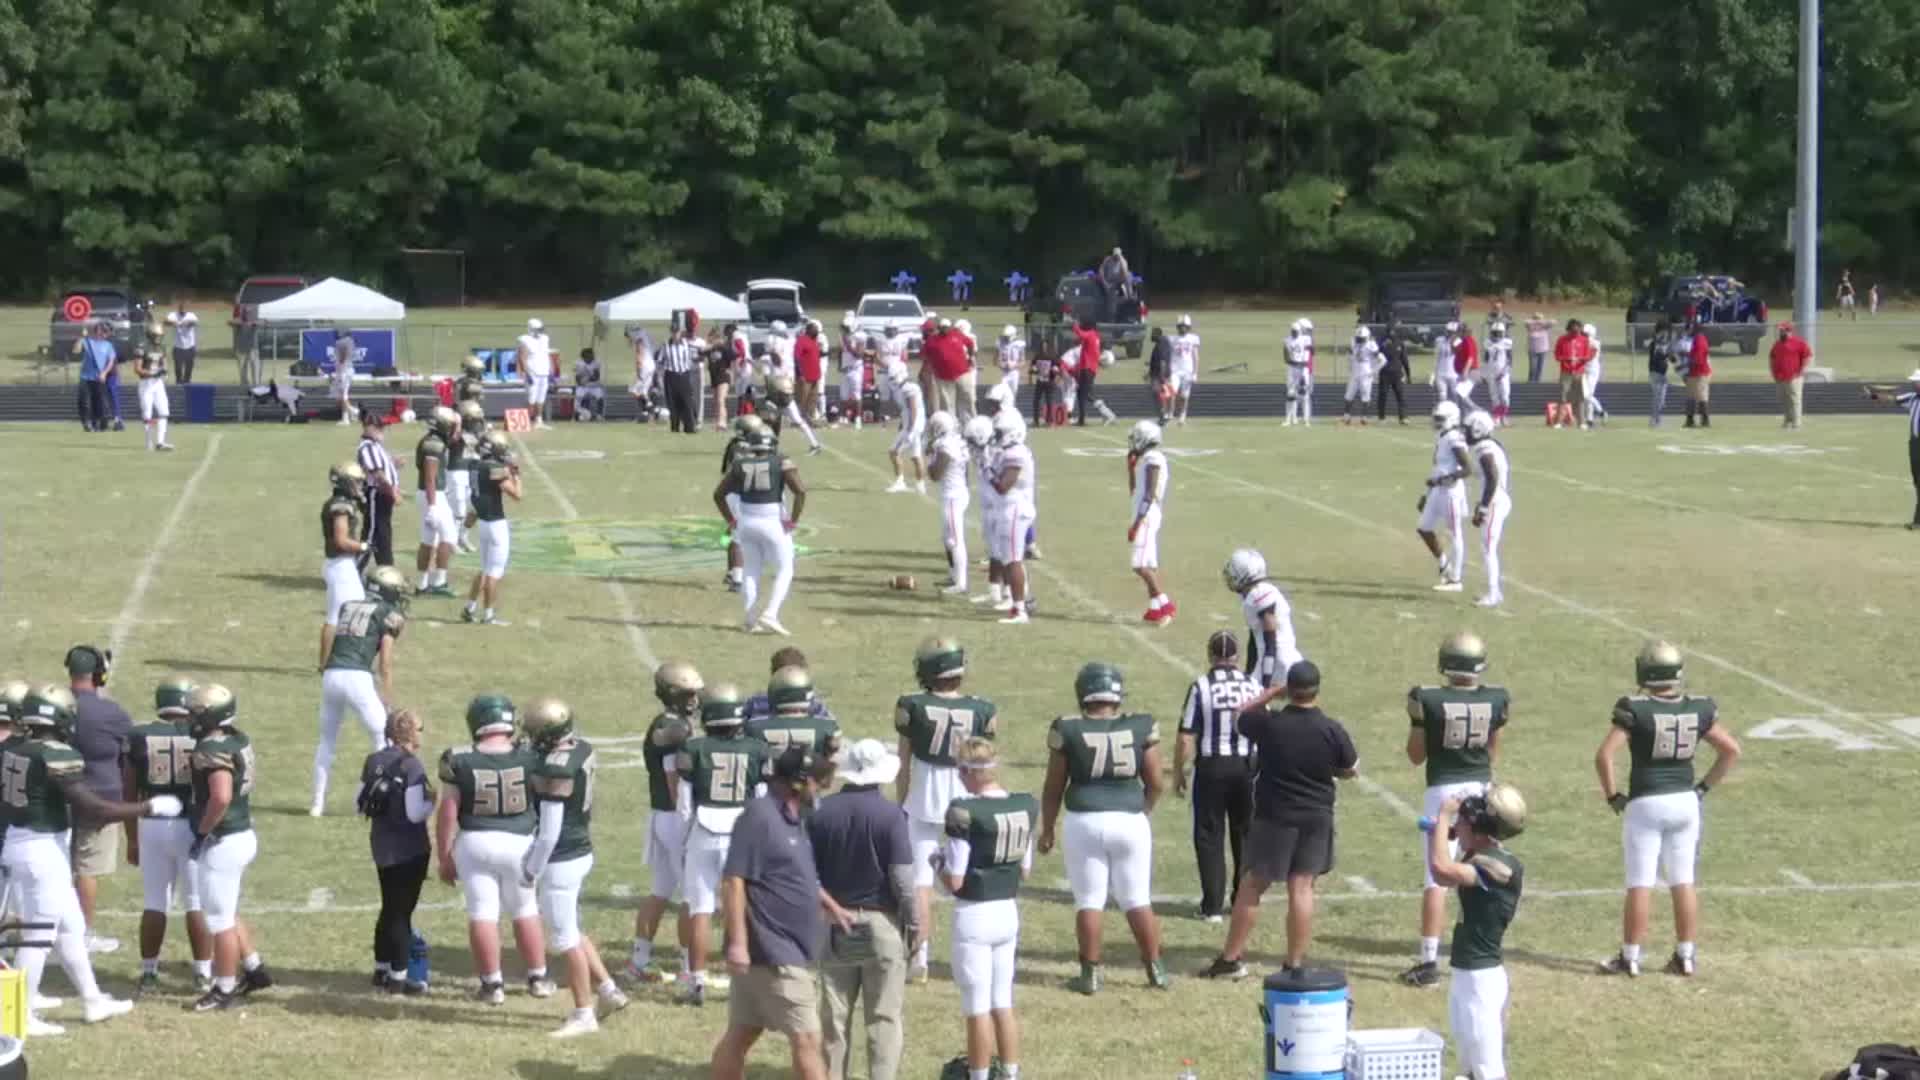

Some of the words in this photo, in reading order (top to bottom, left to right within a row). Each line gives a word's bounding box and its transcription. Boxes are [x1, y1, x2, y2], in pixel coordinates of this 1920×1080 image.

[508, 409, 529, 431] 50
[1209, 682, 1262, 710] 256
[1440, 702, 1492, 750] 69
[1652, 713, 1699, 761] 65
[145, 736, 197, 785] 66
[710, 752, 750, 802] 21
[1082, 730, 1136, 778] 75
[472, 766, 525, 816] 56
[993, 810, 1031, 865] 10
